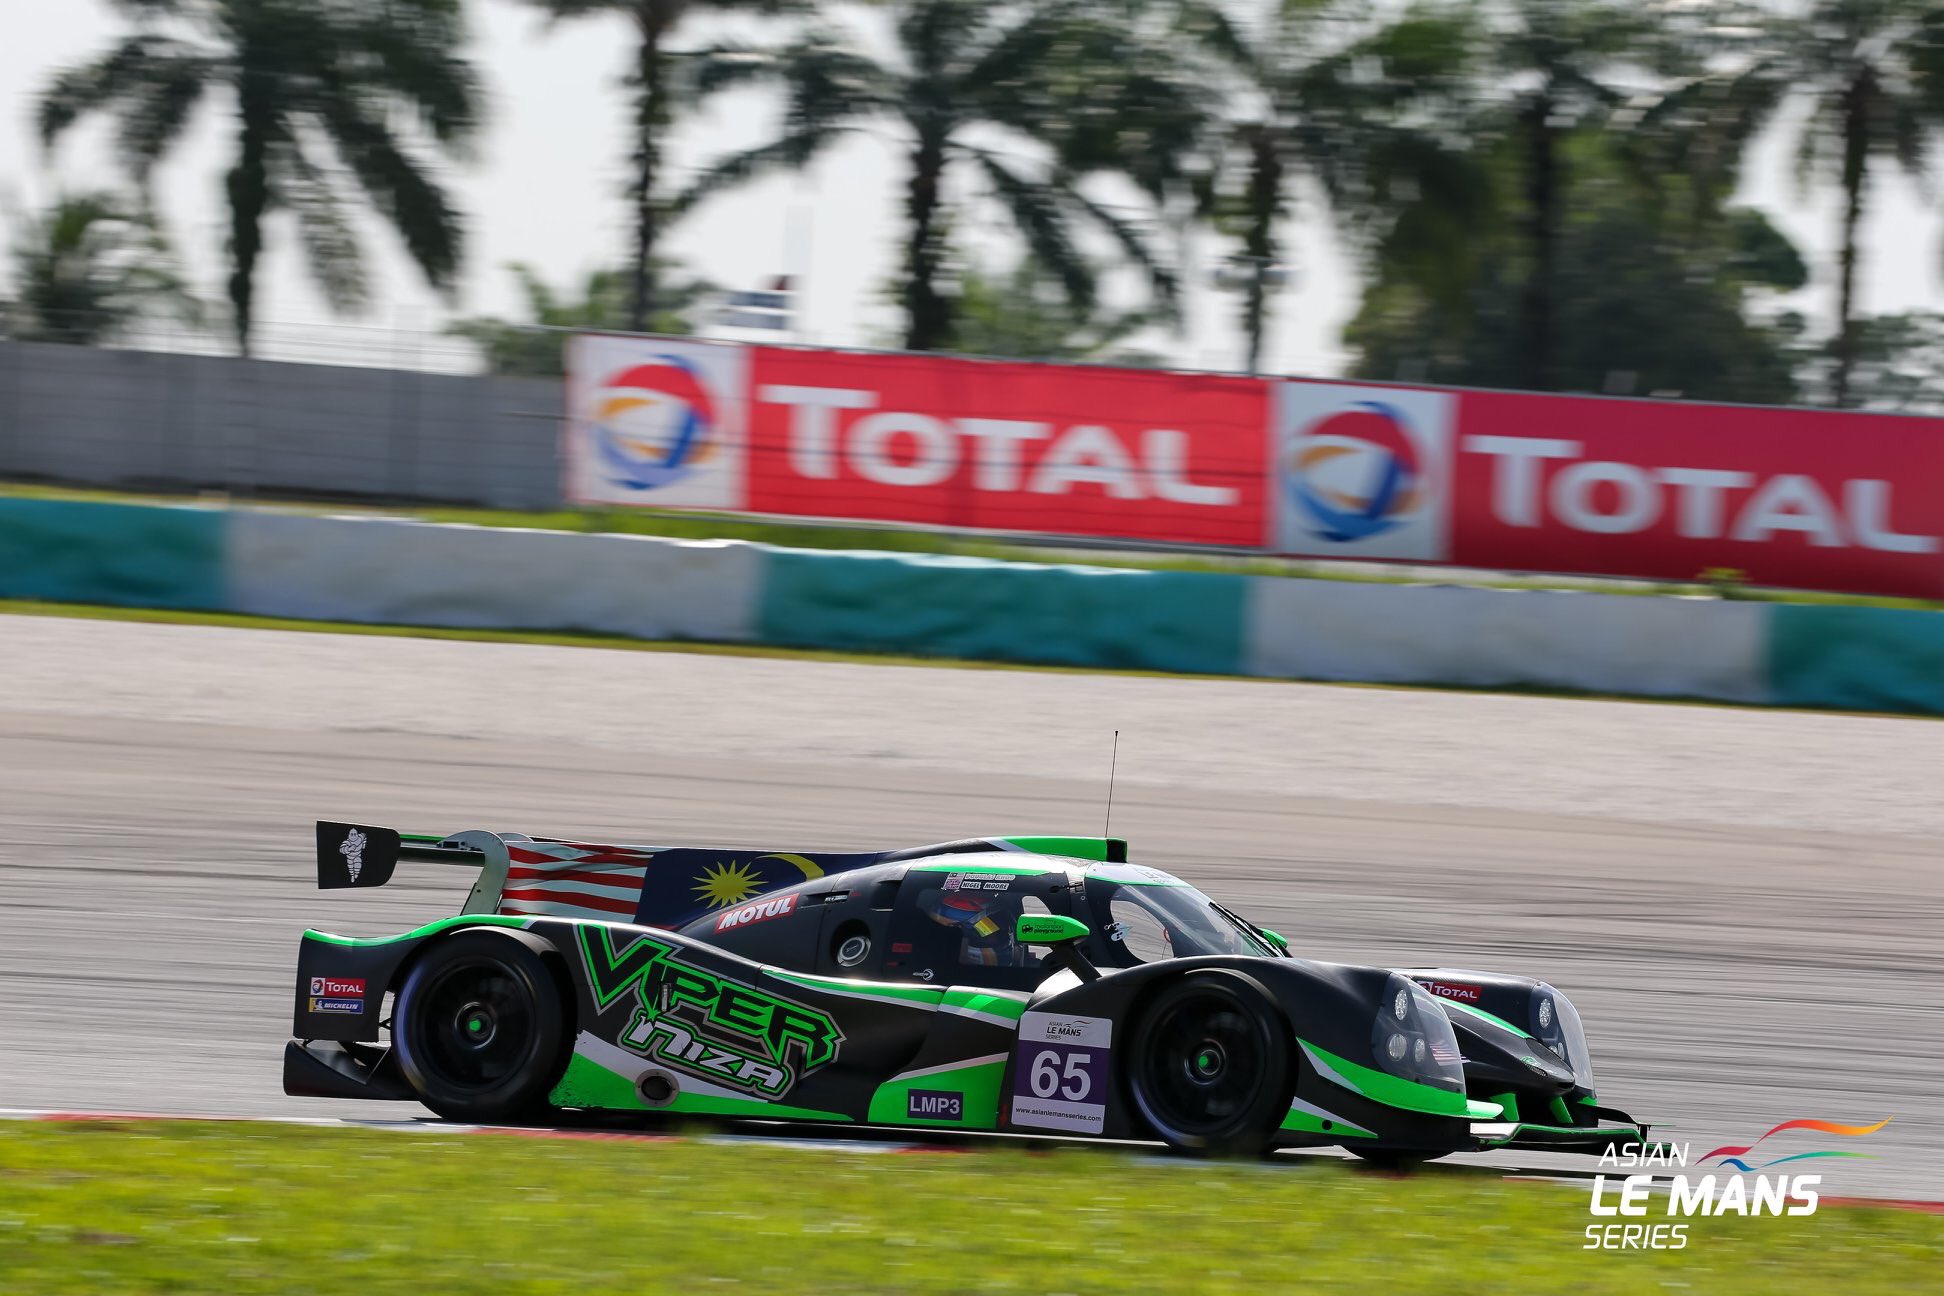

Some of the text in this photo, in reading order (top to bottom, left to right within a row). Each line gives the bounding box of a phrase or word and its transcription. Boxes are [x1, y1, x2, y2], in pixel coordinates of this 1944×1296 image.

[759, 384, 1239, 506] TOTAL
[1462, 434, 1940, 553] TOTAL
[961, 881, 1009, 890] NIGEL MOORE
[718, 897, 792, 930] MOTUL
[326, 981, 363, 993] TOTAL
[1434, 985, 1478, 999] TOTAL
[323, 1002, 359, 1010] MICHELIN
[574, 922, 846, 1076] VIPER
[1046, 1026, 1082, 1037] LE MANS
[1030, 1050, 1092, 1101] 65
[910, 1095, 960, 1115] LMP3
[1015, 1107, 1102, 1122] www.asianlemansseries.com
